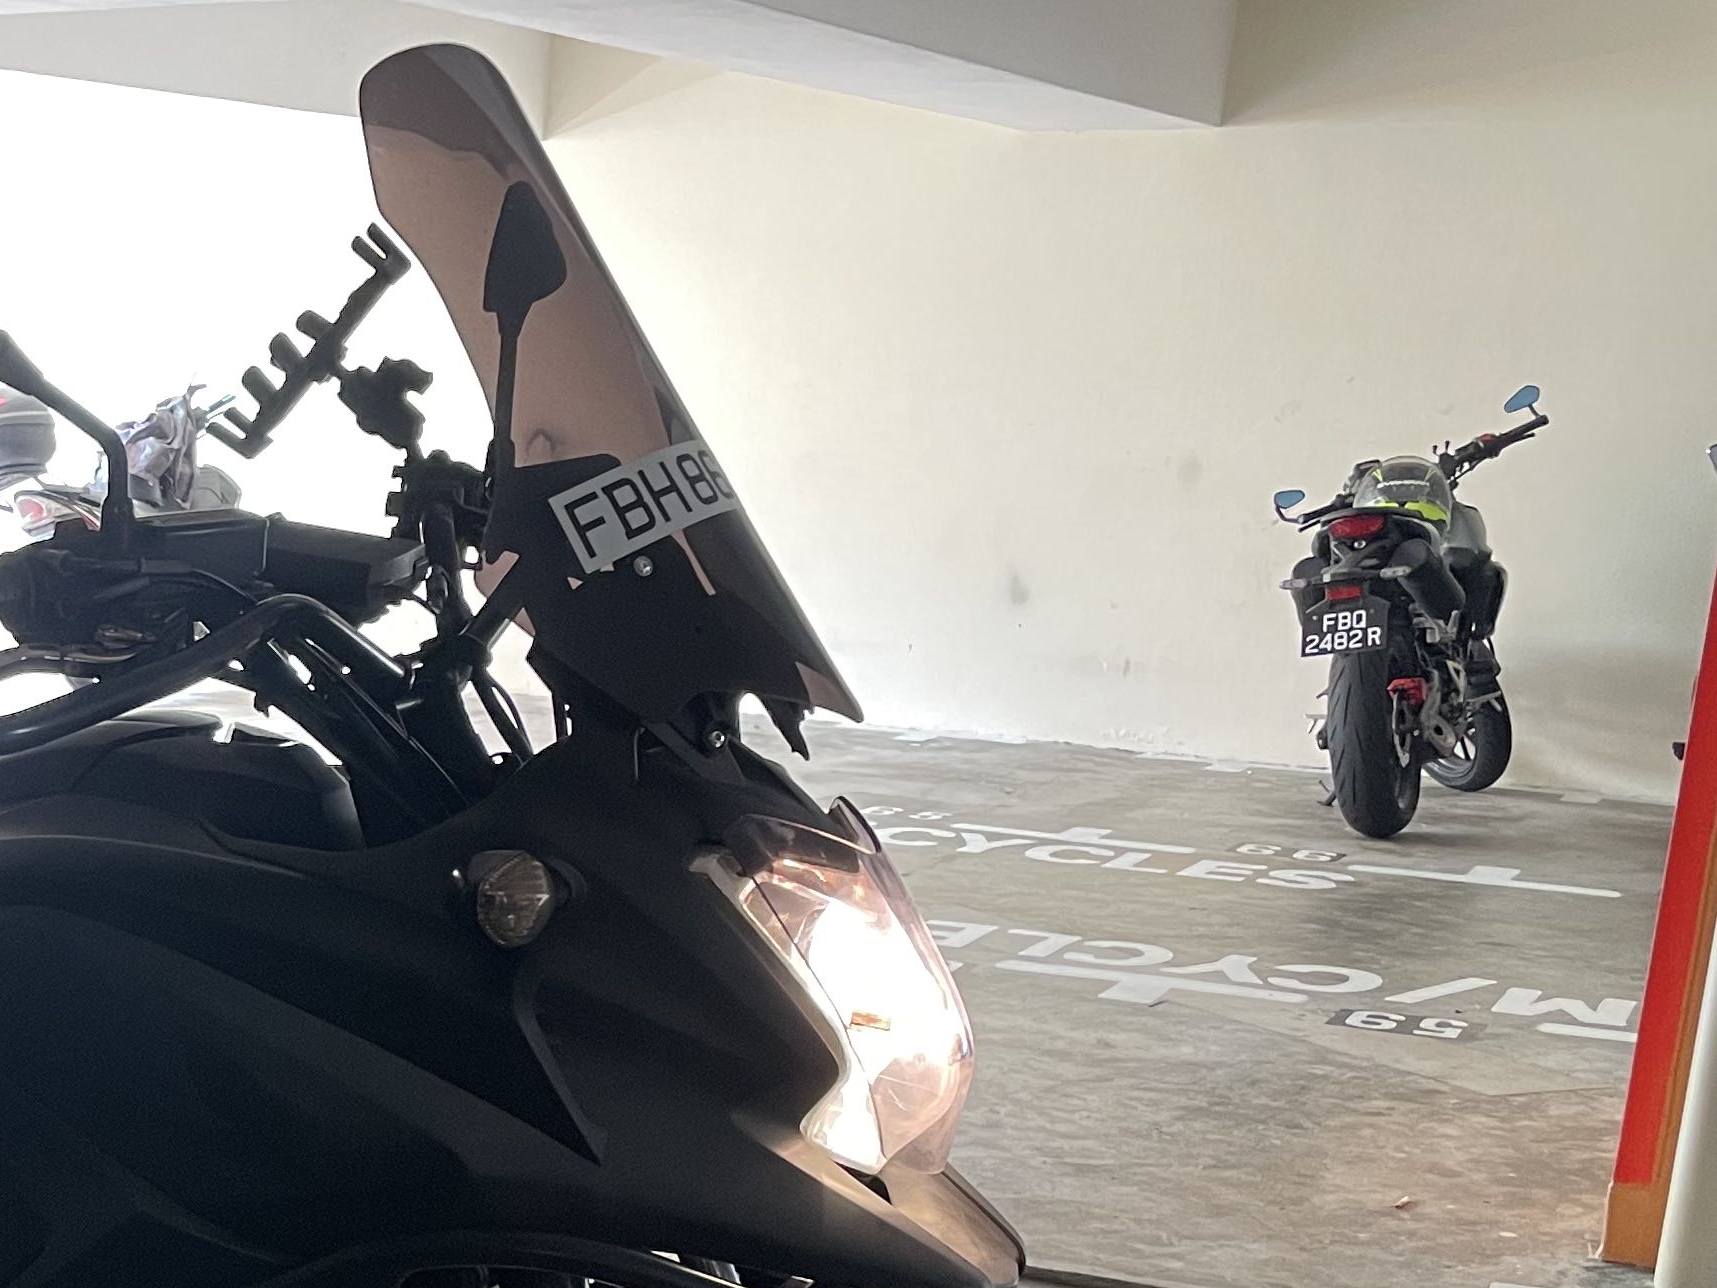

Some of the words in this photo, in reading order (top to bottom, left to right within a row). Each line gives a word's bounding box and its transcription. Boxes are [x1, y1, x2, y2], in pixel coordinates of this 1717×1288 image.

[1323, 609, 1367, 633] FBQ
[871, 821, 1356, 890] CYCLES
[927, 919, 1638, 1027] M/CYCLE
